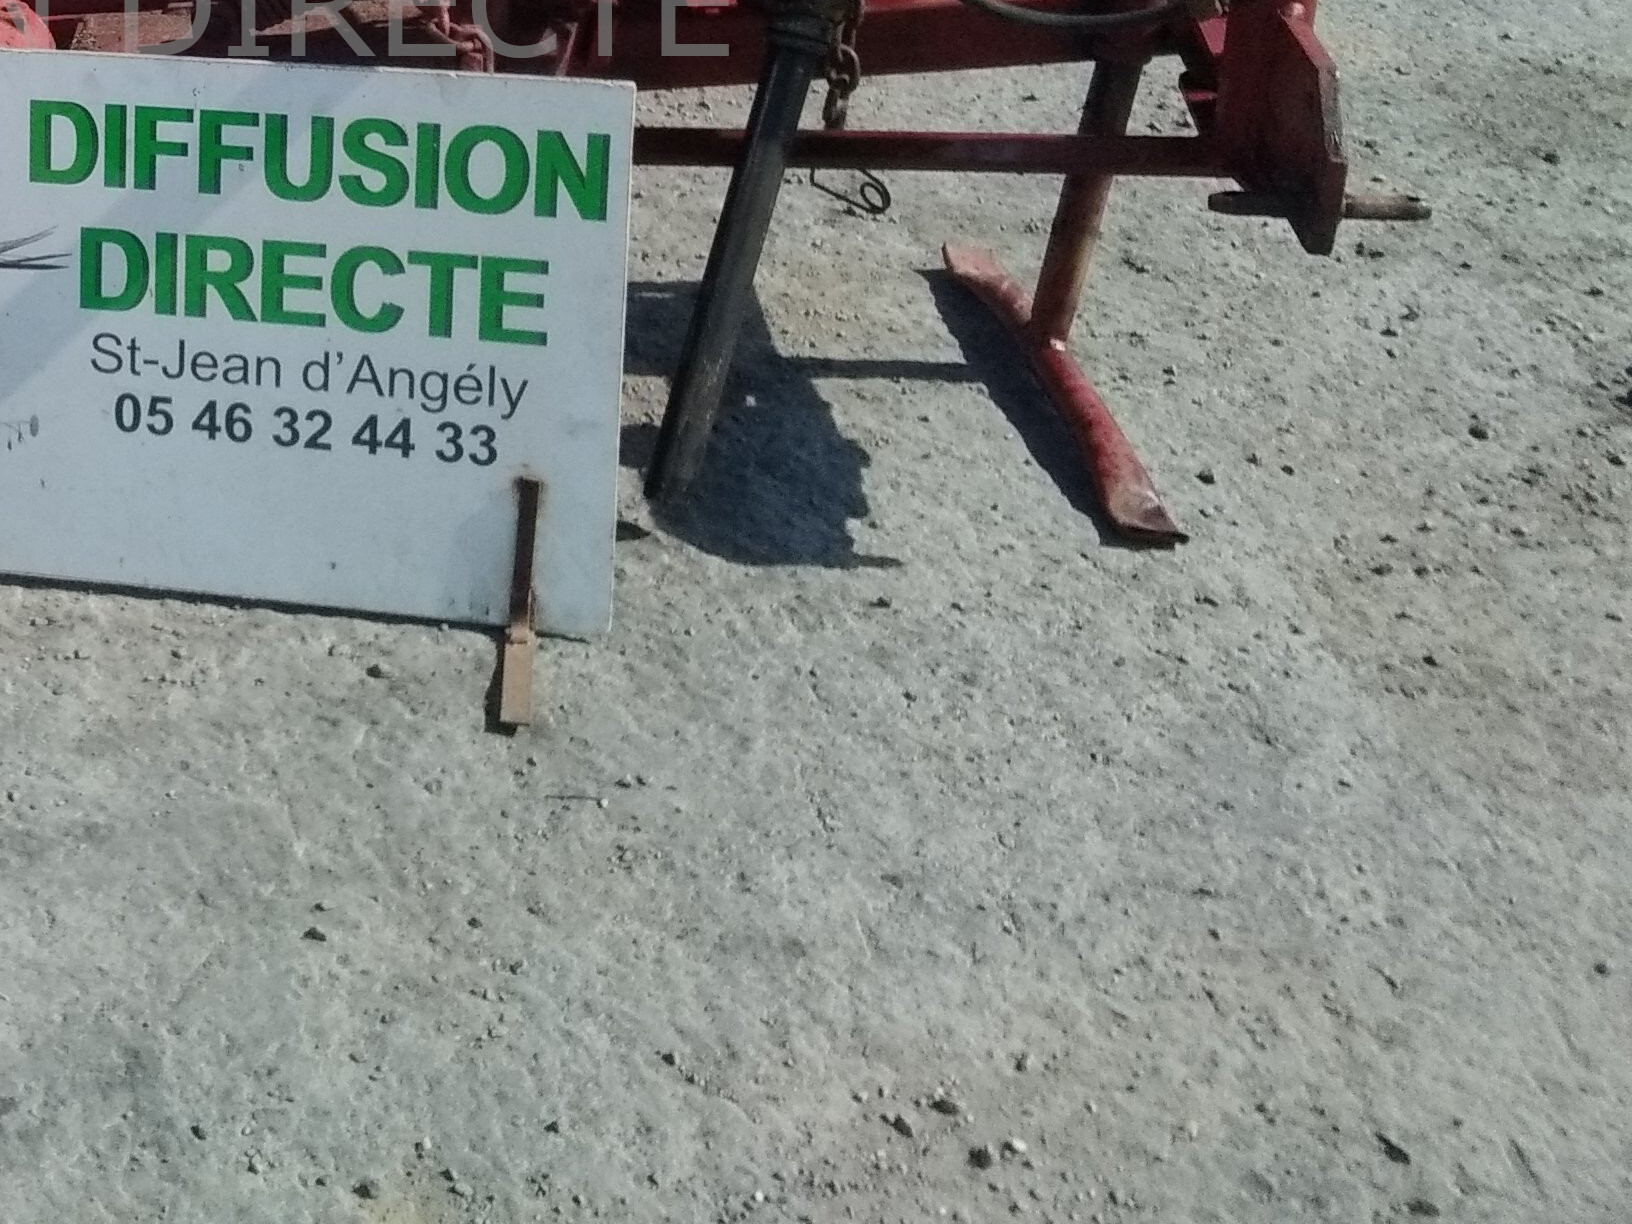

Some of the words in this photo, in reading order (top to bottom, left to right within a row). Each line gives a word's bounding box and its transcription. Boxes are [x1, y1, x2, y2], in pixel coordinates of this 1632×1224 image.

[28, 98, 612, 222] DIFFUSION
[78, 225, 550, 347] DIRECTE
[89, 331, 282, 389] St-Jean
[113, 391, 175, 437] 05
[190, 399, 254, 444] 46
[271, 405, 334, 452] 32
[350, 413, 416, 459] 44
[434, 420, 499, 467] 33
